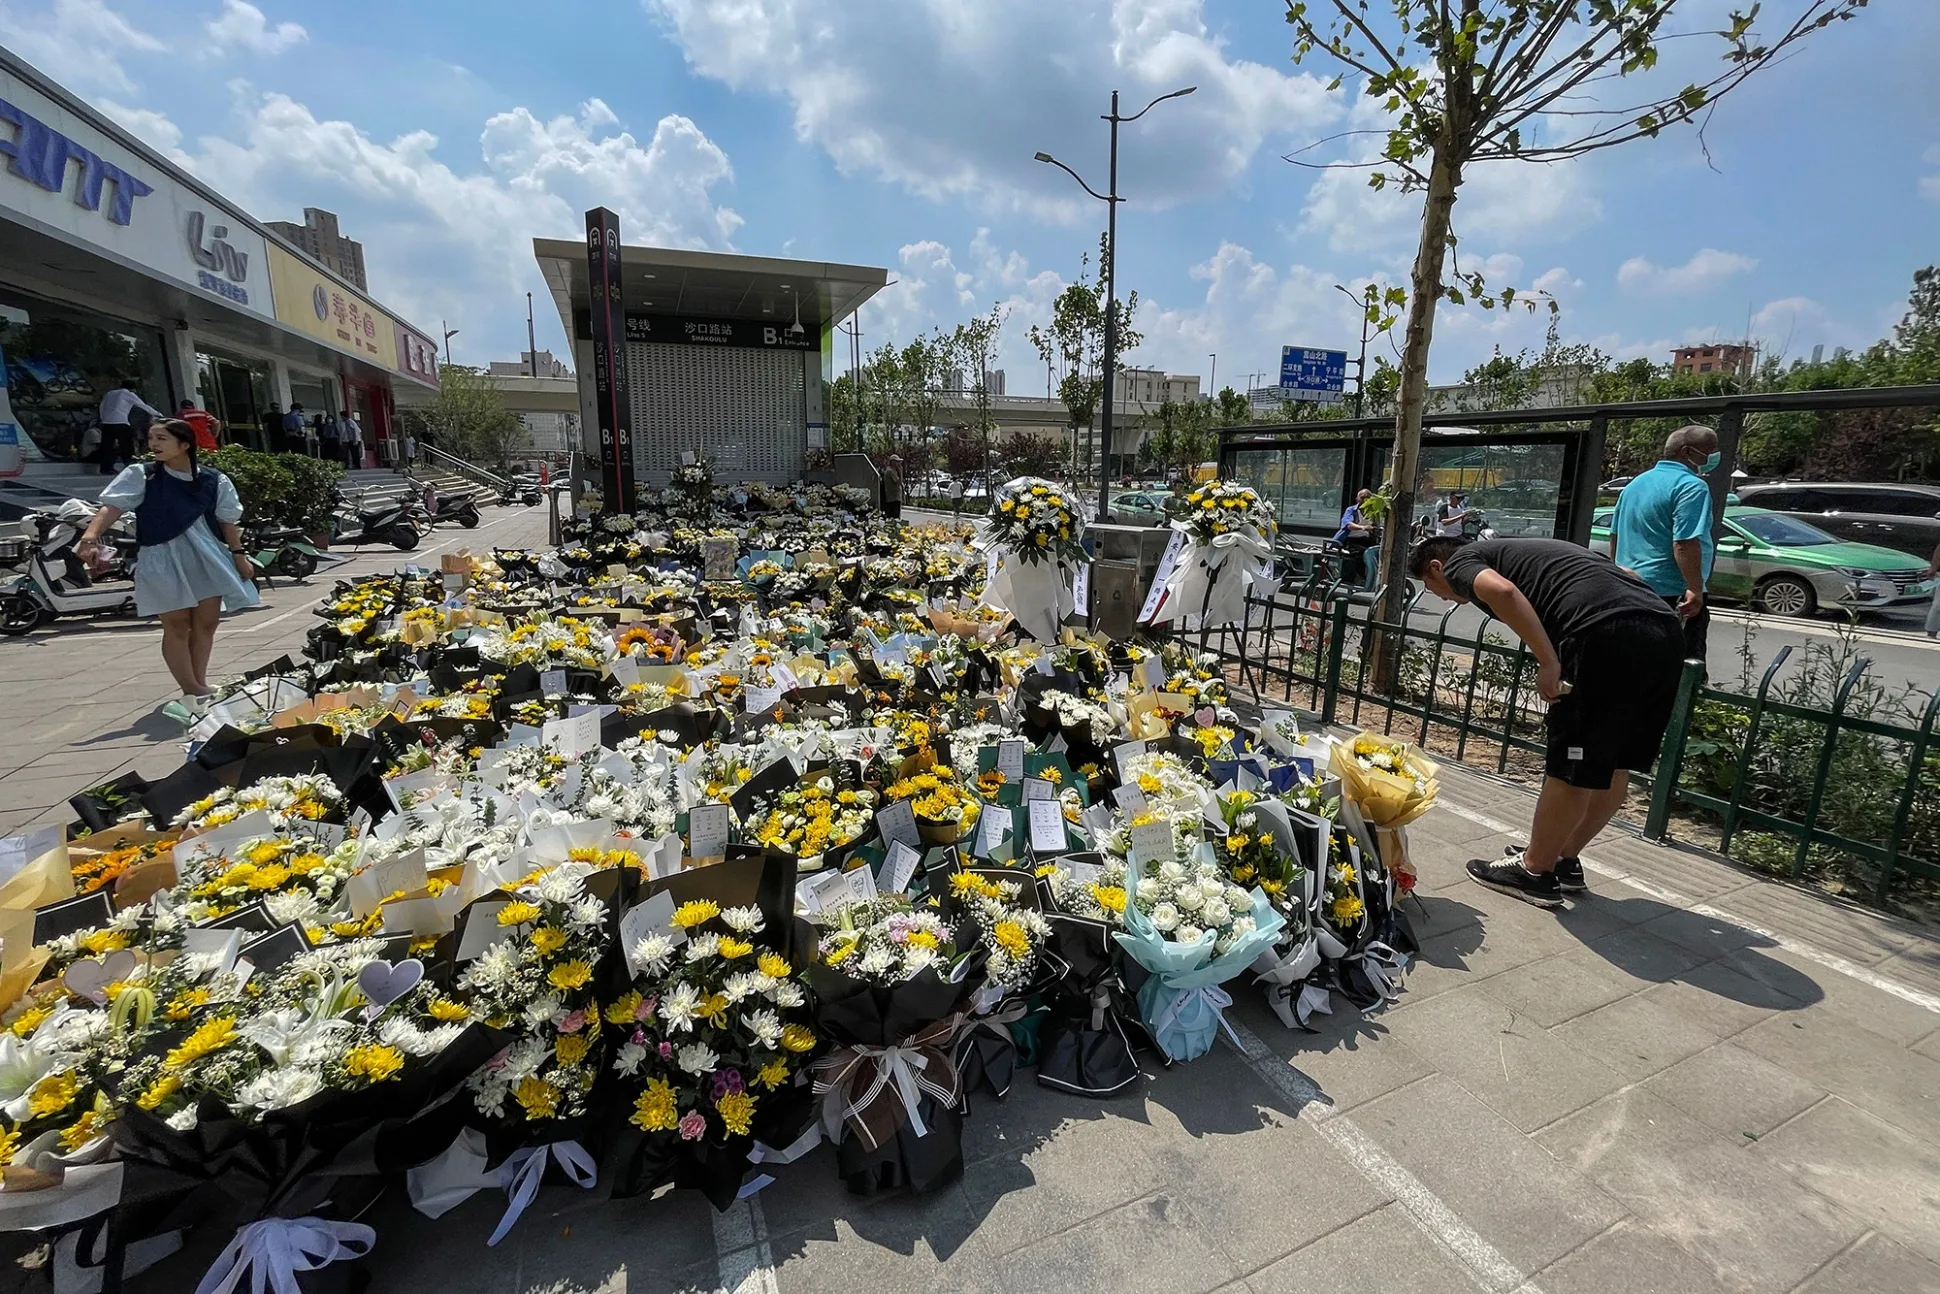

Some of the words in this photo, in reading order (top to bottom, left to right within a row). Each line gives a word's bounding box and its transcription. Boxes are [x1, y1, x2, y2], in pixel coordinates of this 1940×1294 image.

[187, 210, 249, 282] Liv
[685, 322, 732, 335] 沙口路站
[691, 335, 727, 343] SHAKOULU
